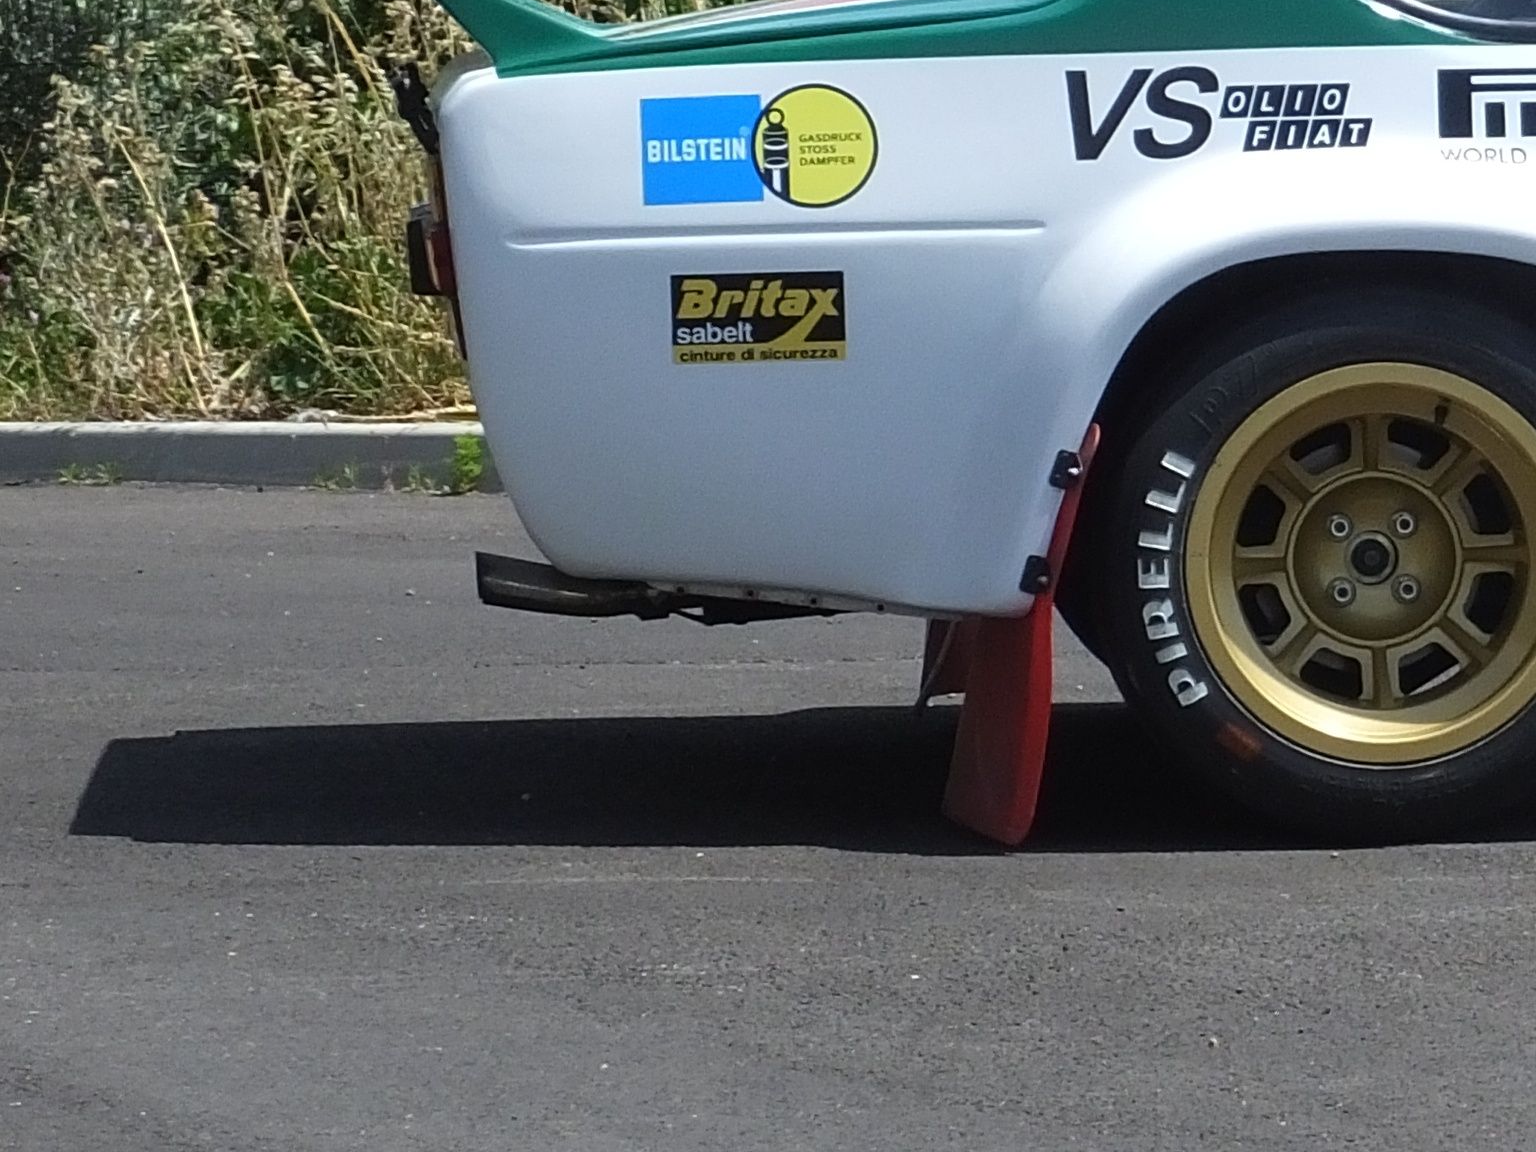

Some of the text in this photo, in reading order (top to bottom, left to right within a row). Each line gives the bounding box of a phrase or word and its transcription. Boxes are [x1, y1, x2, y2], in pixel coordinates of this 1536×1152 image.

[1065, 66, 1219, 160] VS
[1226, 86, 1343, 114] OLIO
[799, 132, 862, 143] GASDRUCK
[1250, 121, 1365, 148] FIAT
[647, 136, 747, 164] BILSTEIN
[799, 145, 837, 155] STOSS
[1440, 147, 1527, 165] WORLD
[676, 278, 841, 320] Britax
[676, 321, 754, 345] sabelt
[679, 347, 839, 362] cinture di sicurezza
[1138, 451, 1209, 708] PIRELLI
